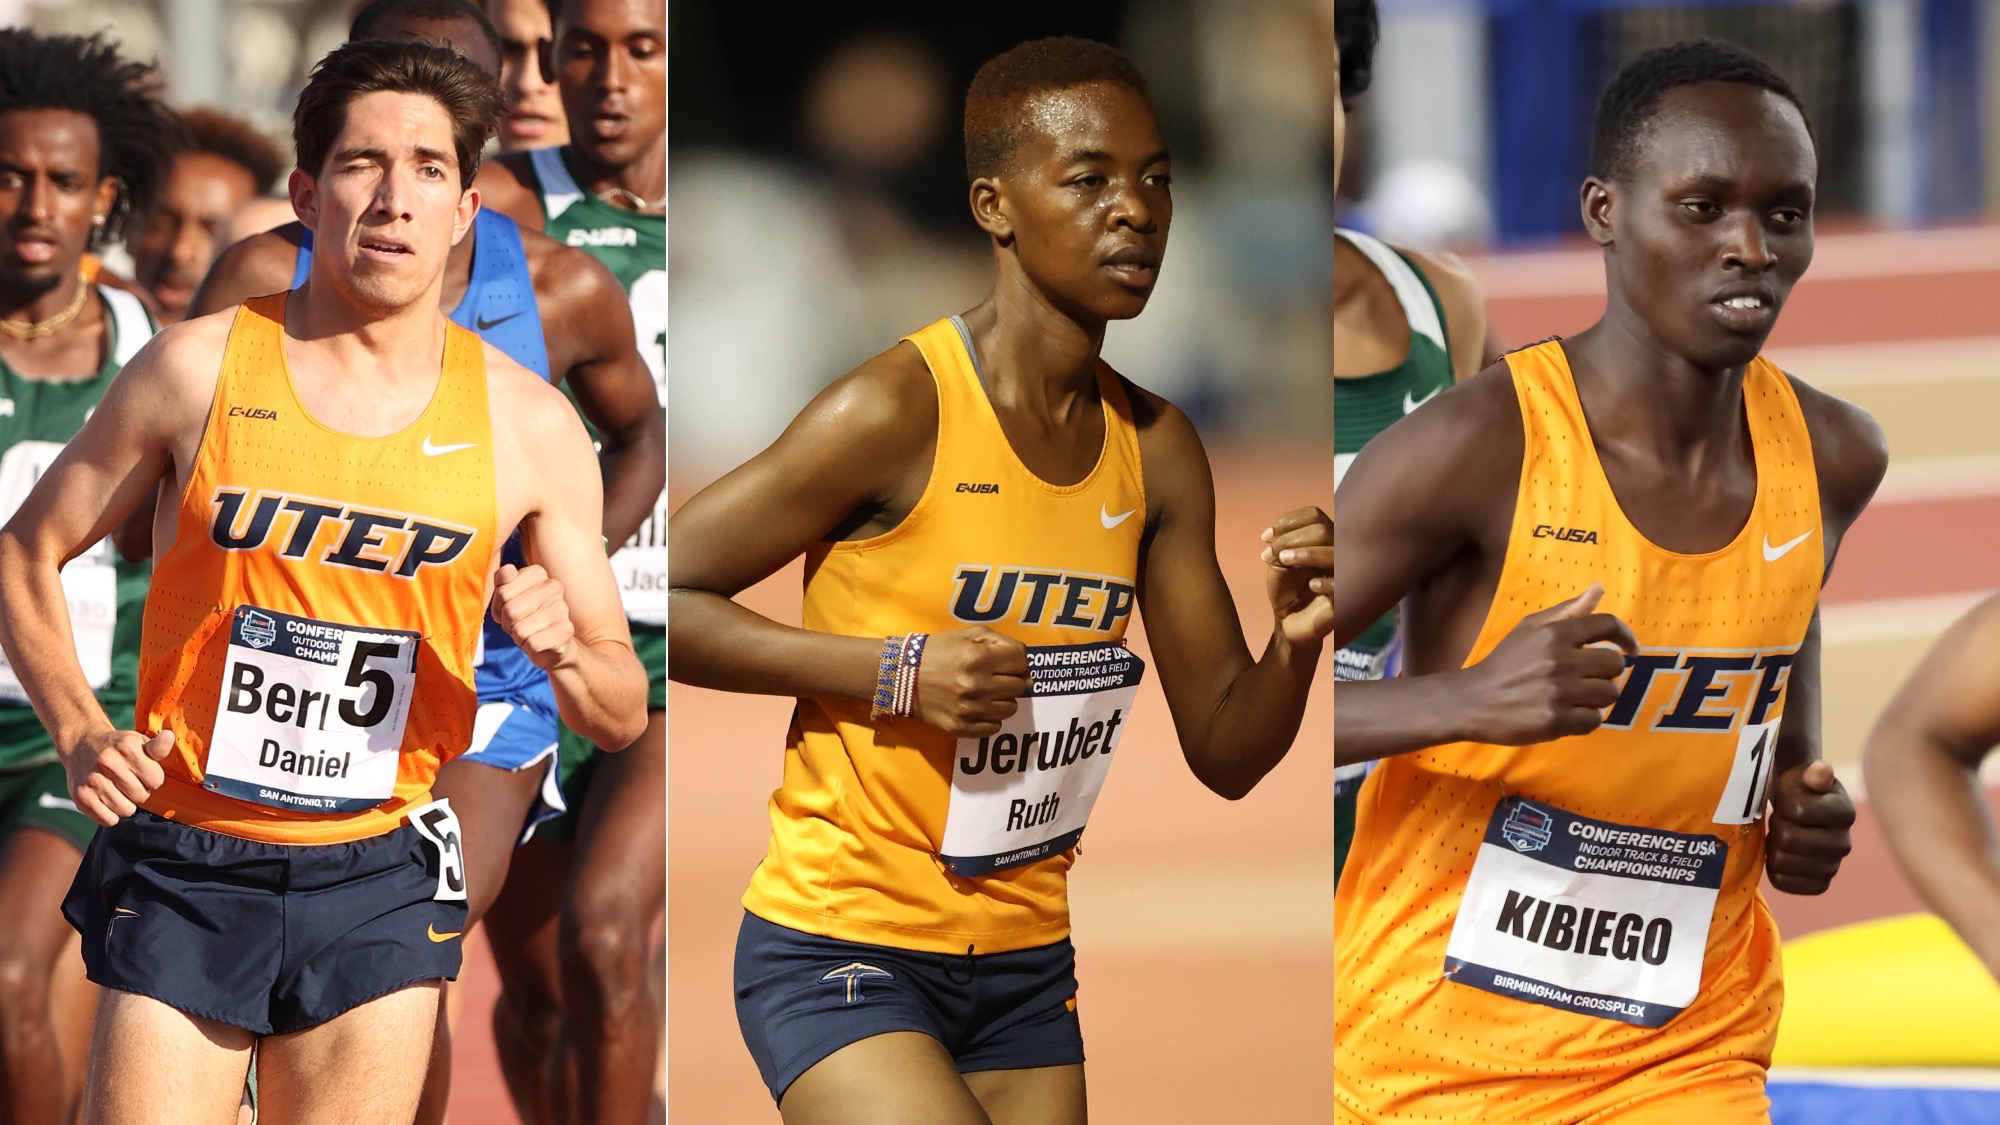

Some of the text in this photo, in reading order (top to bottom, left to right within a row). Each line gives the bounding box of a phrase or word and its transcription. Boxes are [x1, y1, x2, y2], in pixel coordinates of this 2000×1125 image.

[209, 486, 478, 580] UTEP
[949, 564, 1135, 633] UTEP
[286, 620, 343, 641] CONFER
[291, 635, 336, 651] OUTDOOR
[295, 646, 339, 663] CHAMP
[1030, 669, 1073, 679] OUTDOOR
[1075, 665, 1101, 676] TRACK
[1109, 662, 1130, 673] FIELD
[338, 640, 400, 728] 5
[1033, 674, 1125, 693] CHAMPIONSHIPS
[1600, 648, 1796, 733] TEP
[259, 738, 351, 778] Daniel
[960, 709, 1122, 776] Jerubet
[259, 789, 337, 808] SAN ANTONIO, TX
[1006, 792, 1060, 832] Ruth
[420, 808, 464, 892] 5
[994, 856, 1010, 867] SAN
[1042, 844, 1050, 853] TX
[1568, 821, 1717, 856] CONFERENCE USA
[1578, 842, 1703, 869] INDOOR TRACK & FIELD
[1574, 855, 1697, 882] CHAMPIONSHIPS
[1496, 889, 1673, 966] KIBIEGO
[1493, 974, 1646, 1018] BIRMINGHAM CROSSPLEX
